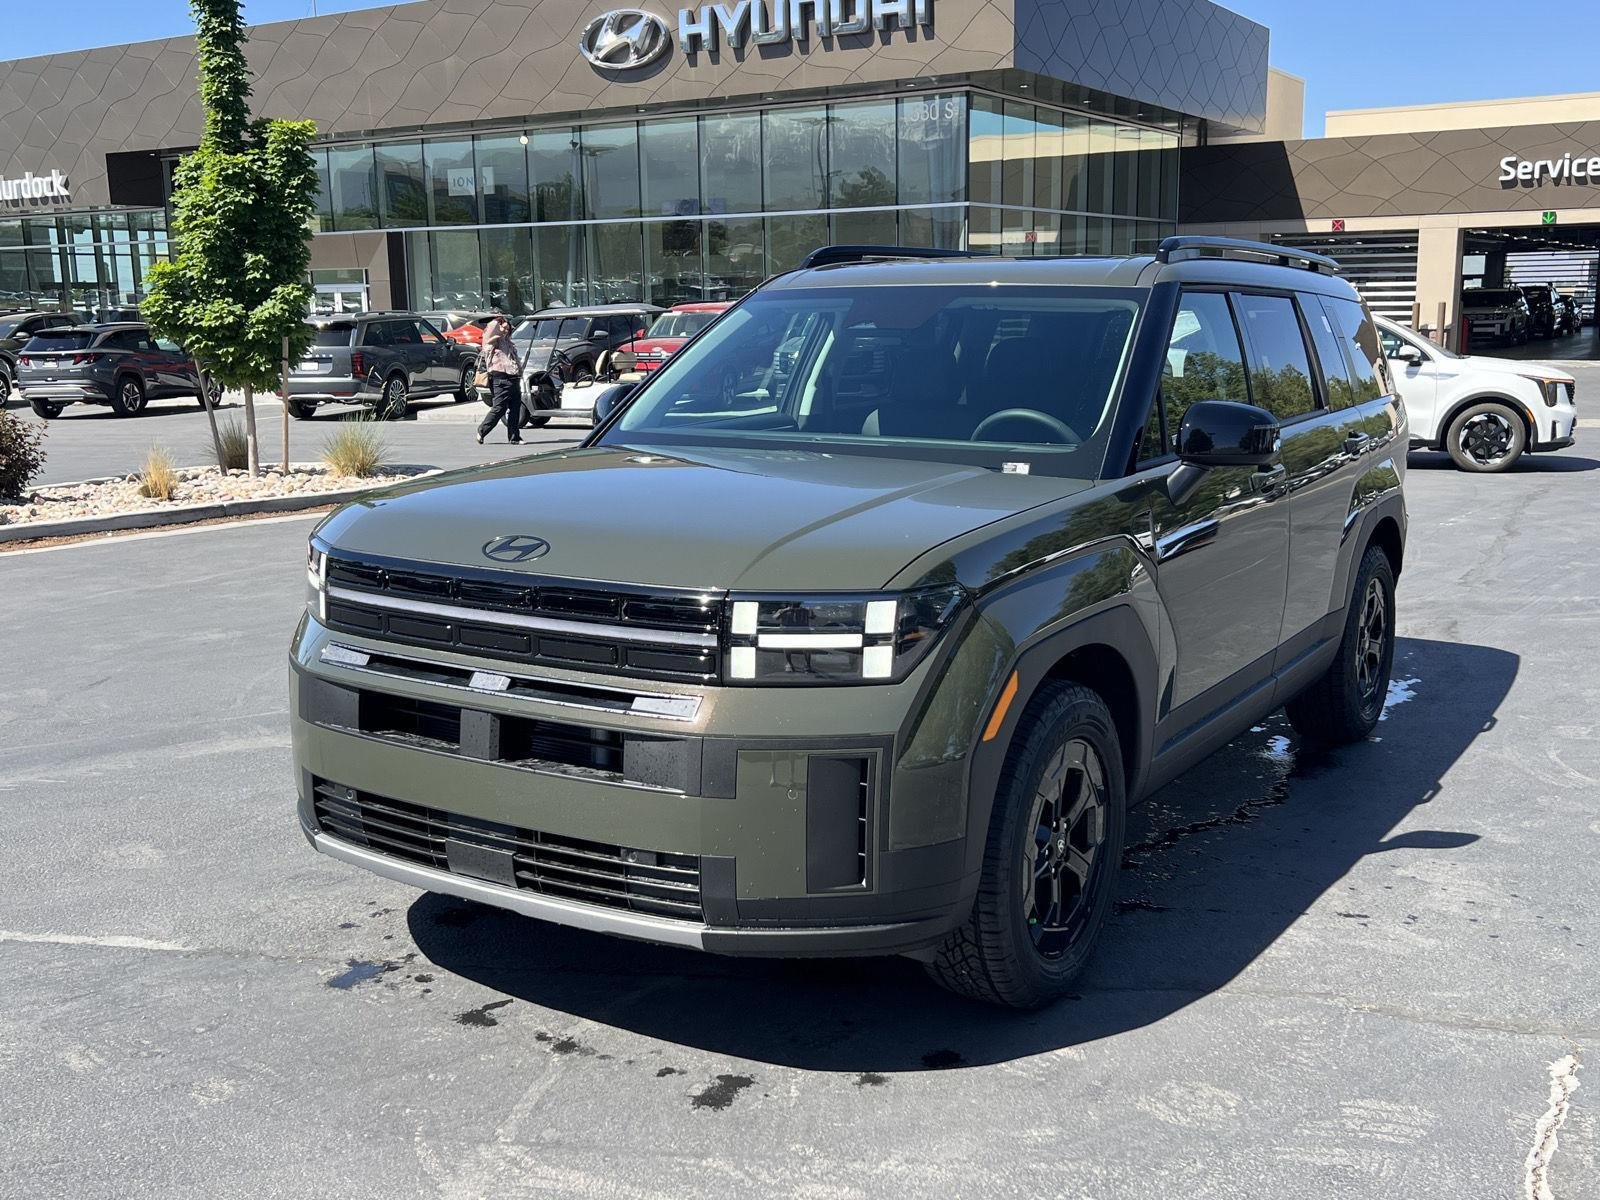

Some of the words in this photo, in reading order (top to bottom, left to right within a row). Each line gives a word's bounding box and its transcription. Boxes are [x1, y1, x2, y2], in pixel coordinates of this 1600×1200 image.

[944, 101, 954, 119] S
[1498, 152, 1600, 181] Service
[0, 168, 70, 201] urdock
